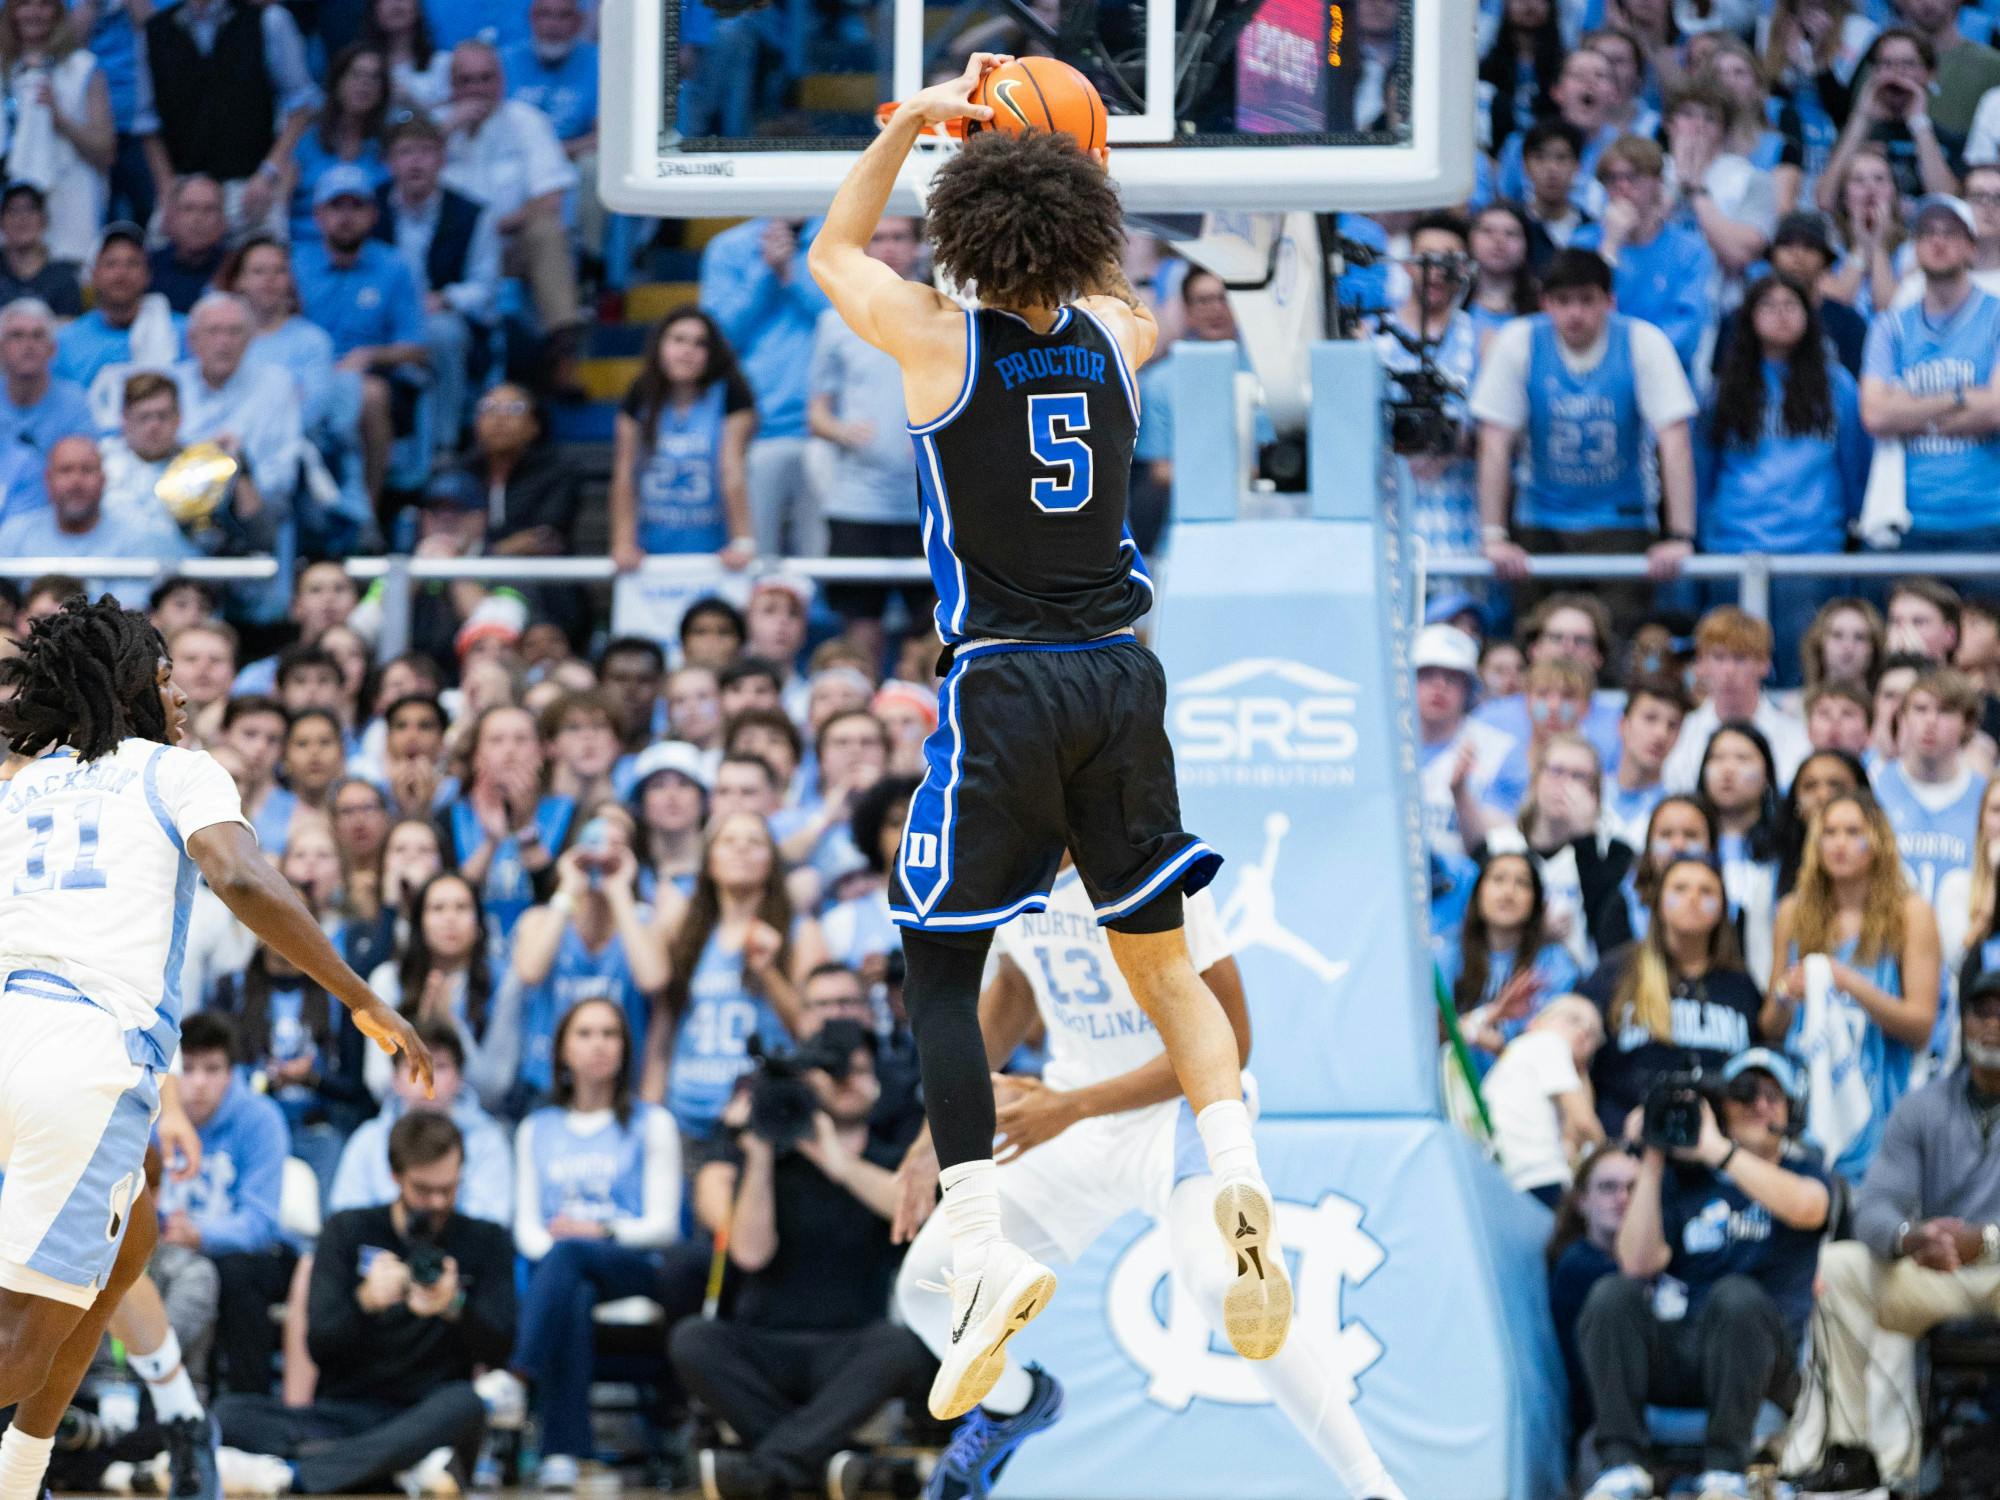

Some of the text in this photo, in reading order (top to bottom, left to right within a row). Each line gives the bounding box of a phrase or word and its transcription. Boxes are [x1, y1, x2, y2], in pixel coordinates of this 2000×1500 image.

[994, 344, 1106, 391] PROCTOR
[1027, 392, 1093, 512] 5
[1175, 697, 1358, 760] SRS
[6, 763, 138, 814] JACKSON
[1180, 766, 1356, 787] DISTRIBUTION
[13, 799, 107, 896] 11
[906, 832, 938, 868] D
[1022, 911, 1102, 943] NORTH
[1033, 946, 1111, 1005] 13
